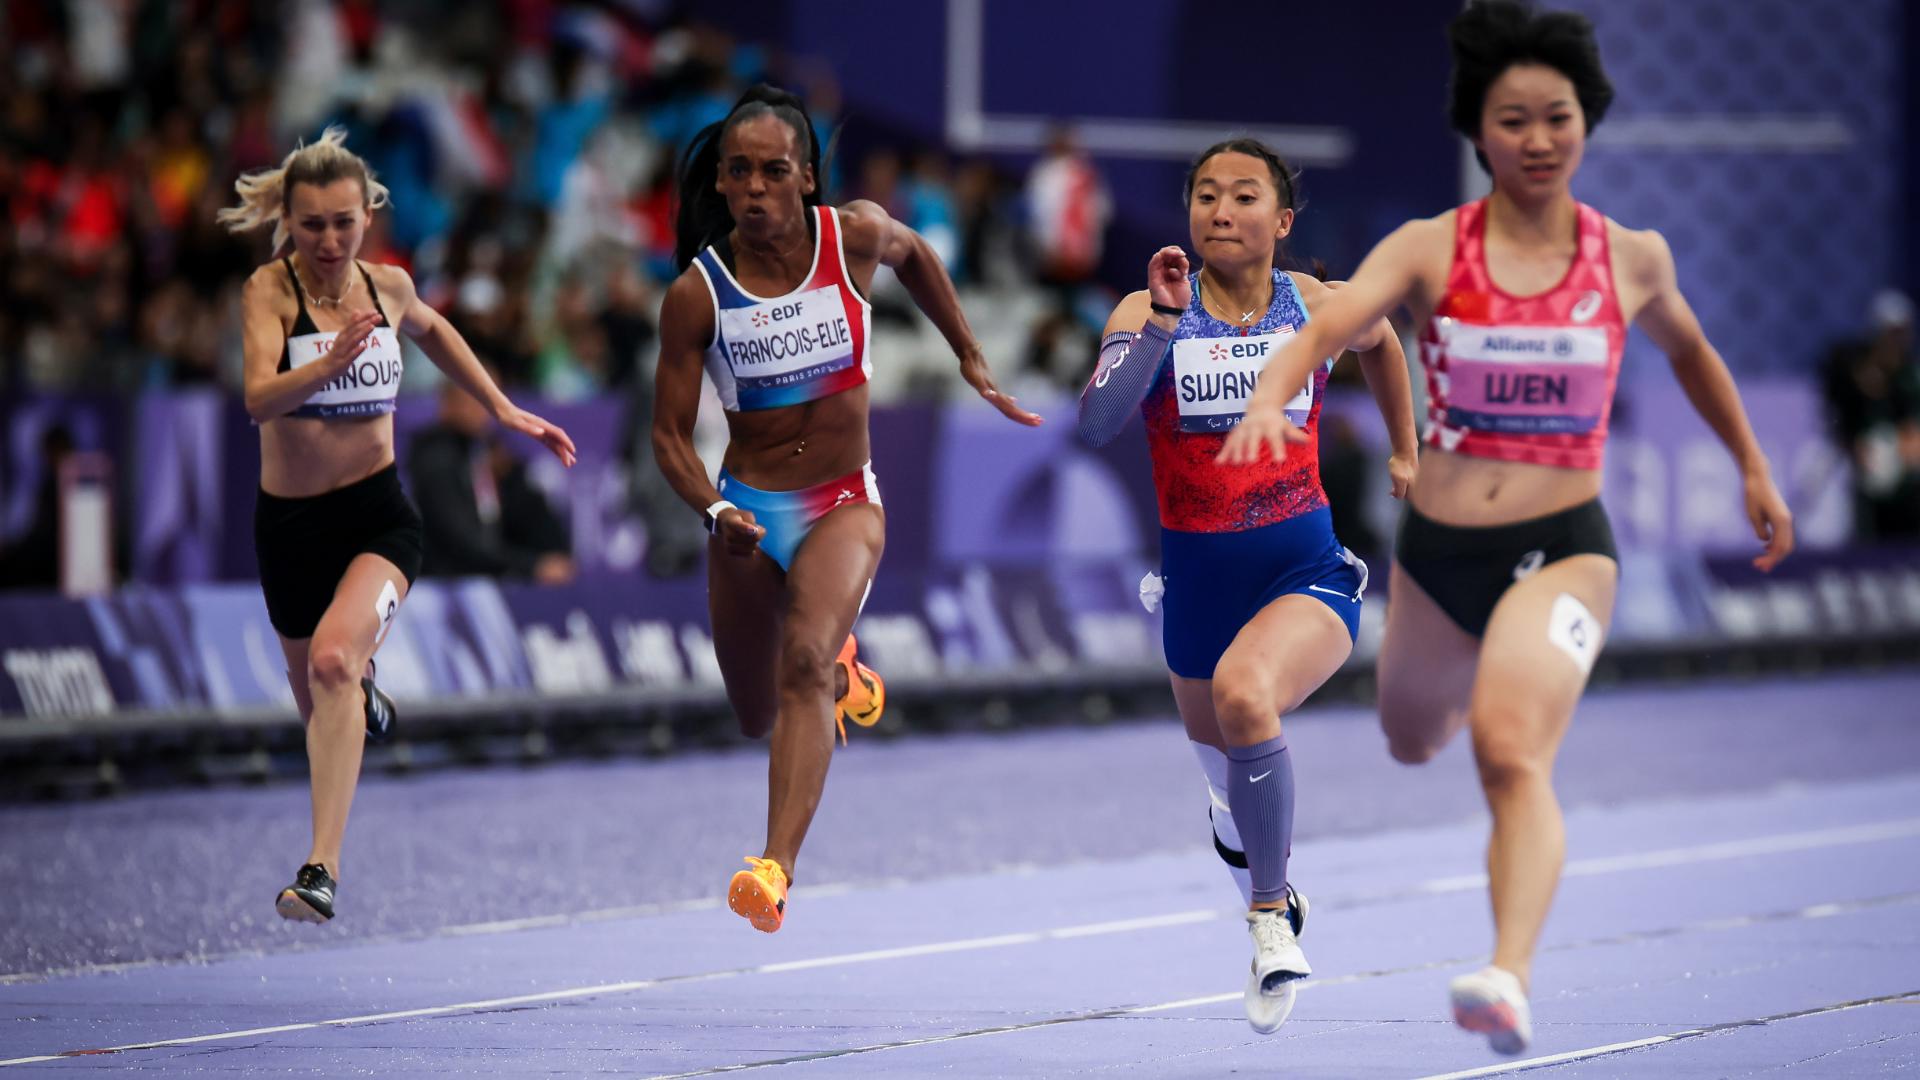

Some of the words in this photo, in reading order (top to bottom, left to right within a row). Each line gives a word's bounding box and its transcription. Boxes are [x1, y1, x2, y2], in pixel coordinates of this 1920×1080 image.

[313, 335, 381, 354] TOA
[729, 317, 849, 366] FRANCOIS-ELIE
[1482, 335, 1546, 352] Allianz
[775, 373, 805, 385] PARIS
[1181, 370, 1310, 403] SWAN
[1485, 373, 1568, 404] WEN
